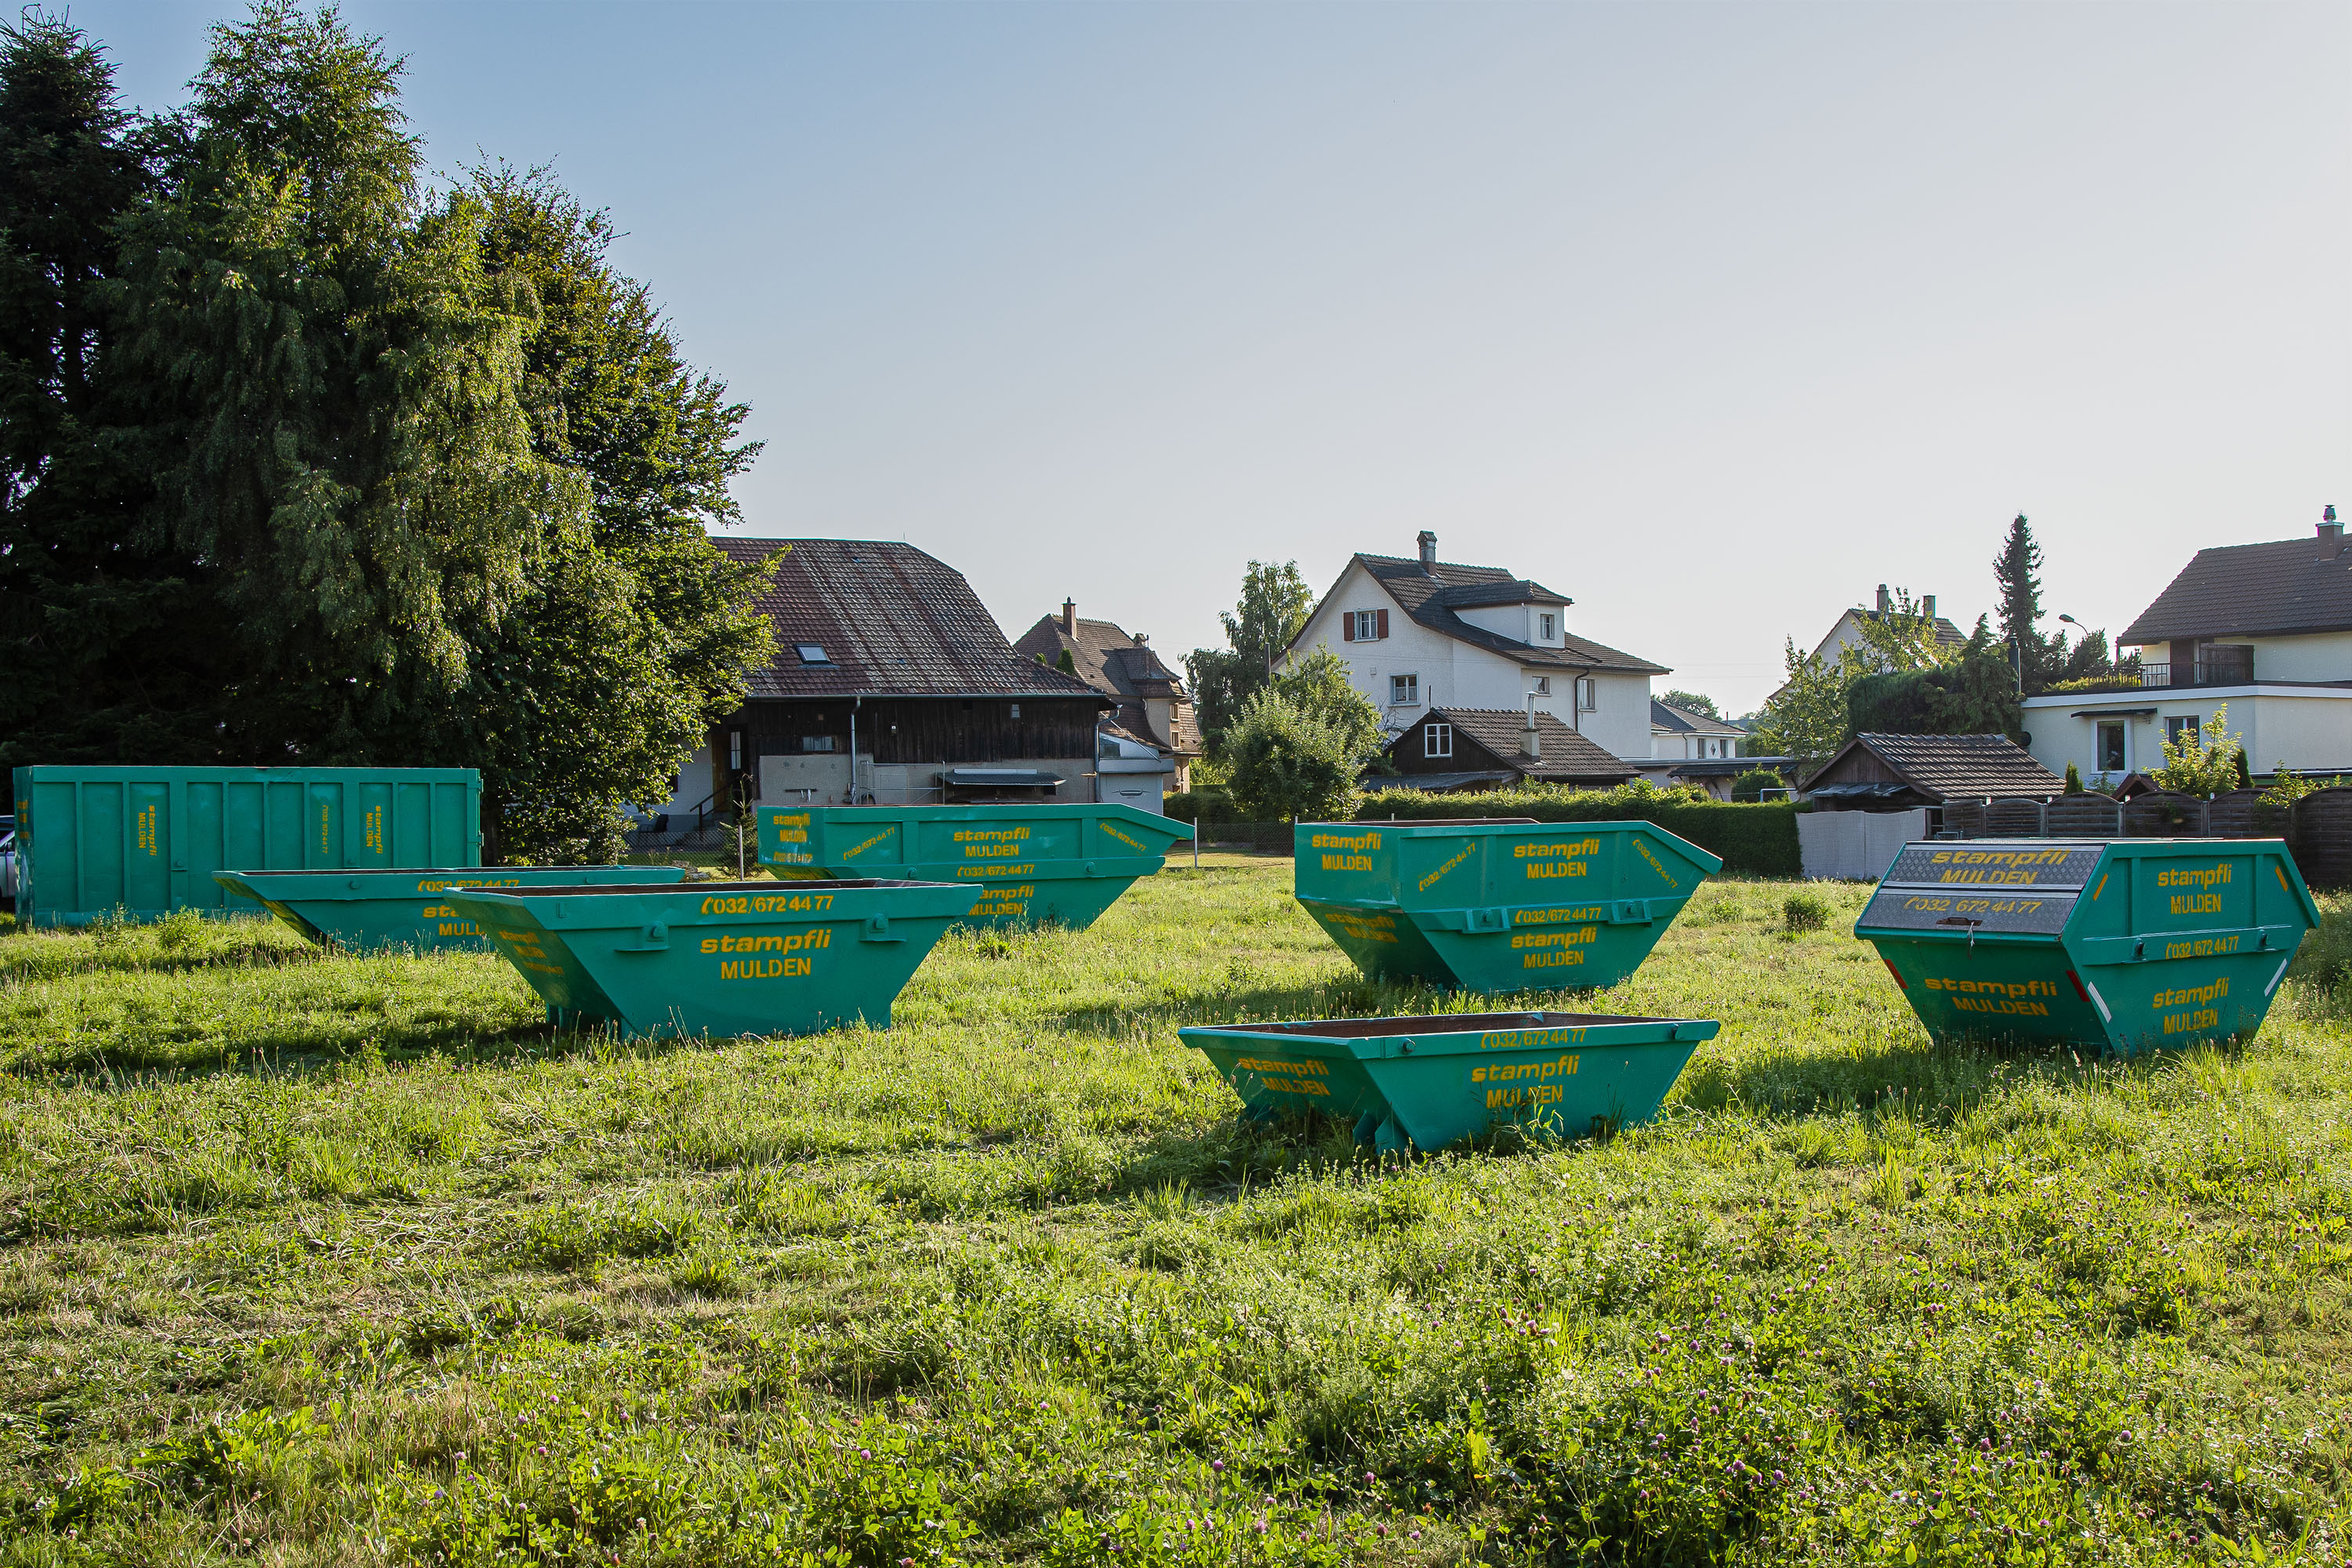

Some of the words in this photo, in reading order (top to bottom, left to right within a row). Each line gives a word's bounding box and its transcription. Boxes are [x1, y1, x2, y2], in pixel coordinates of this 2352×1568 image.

[147, 804, 157, 855] stampfli
[953, 827, 1030, 843] stampfli
[965, 844, 1018, 857] MULDEN
[1312, 833, 1381, 853] stampfli
[1513, 838, 1599, 859] stampfli
[1323, 854, 1372, 872] MULDEN
[1931, 849, 2071, 869] stampfli
[1527, 862, 1587, 879] MULDEN
[1939, 869, 2038, 884] MULDEN
[2158, 864, 2232, 891] stampfli
[979, 885, 1034, 902] ampfli
[2170, 893, 2221, 914] MULDEN
[700, 929, 831, 955] stampfli
[1511, 927, 1597, 949] stampfli
[720, 957, 811, 979] MULDEN
[1523, 950, 1584, 969] MULDEN
[1925, 978, 2057, 999] stampfli
[2152, 977, 2230, 1008] stampfli
[1951, 996, 2049, 1016] MULDEN
[2164, 1008, 2218, 1034] MULDEN
[1238, 1058, 1330, 1078] stampfli
[1472, 1054, 1580, 1082] stampfli
[1261, 1076, 1330, 1096] MULDEN
